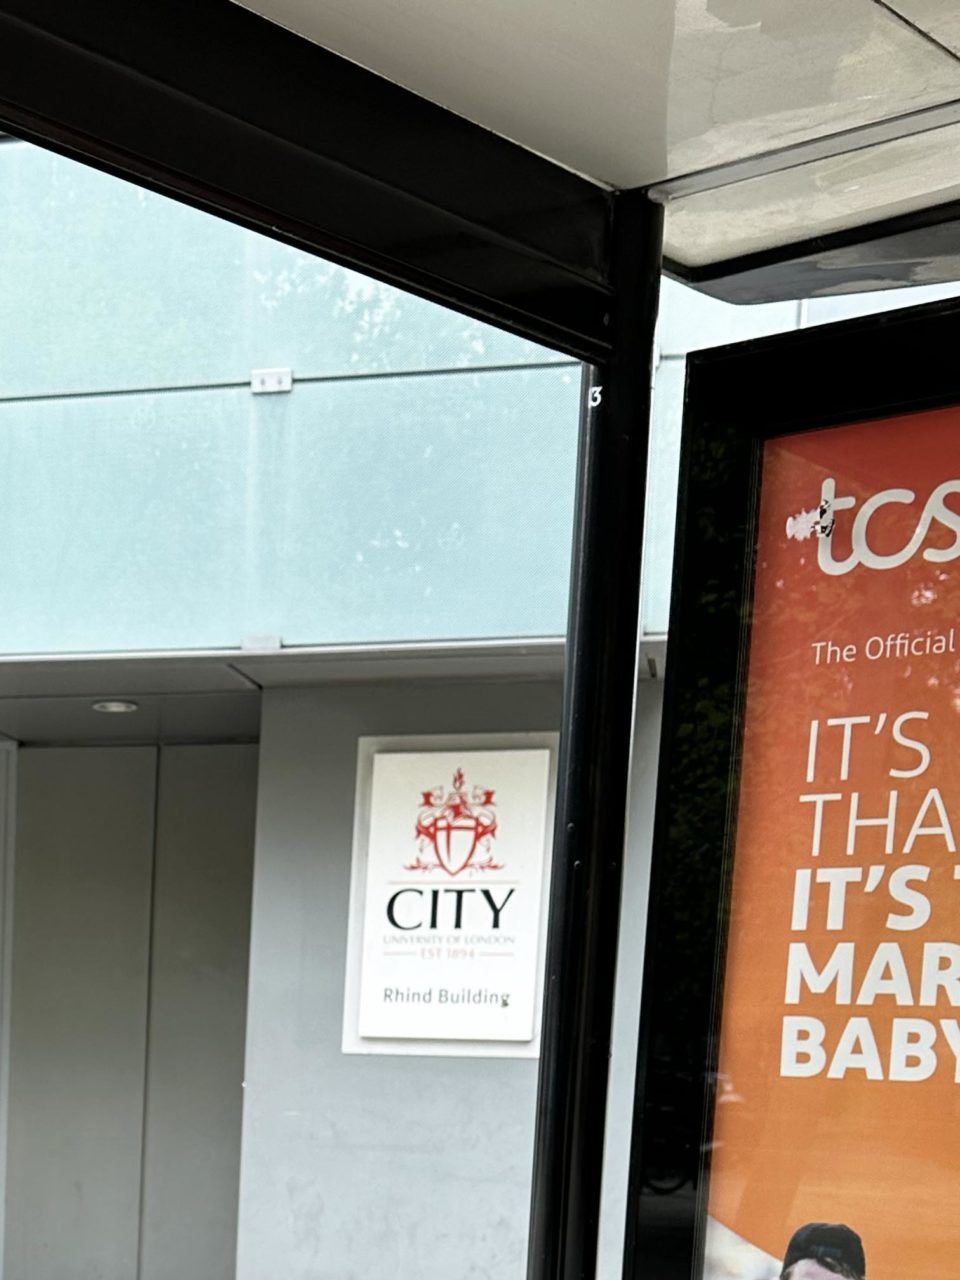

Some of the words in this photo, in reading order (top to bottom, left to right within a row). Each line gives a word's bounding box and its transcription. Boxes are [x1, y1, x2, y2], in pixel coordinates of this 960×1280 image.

[811, 641, 856, 665] The
[865, 629, 956, 660] Official
[806, 711, 931, 783] IT'S
[799, 788, 956, 857] THA
[385, 888, 515, 931] CITY
[791, 864, 931, 931] IT'S
[383, 934, 443, 945] UNIVERSITY
[446, 935, 460, 945] OF
[464, 935, 515, 945] LONDON
[420, 948, 442, 959] EST
[784, 942, 960, 1006] MAR
[384, 987, 433, 1004] Rhind
[438, 988, 510, 1008] Building
